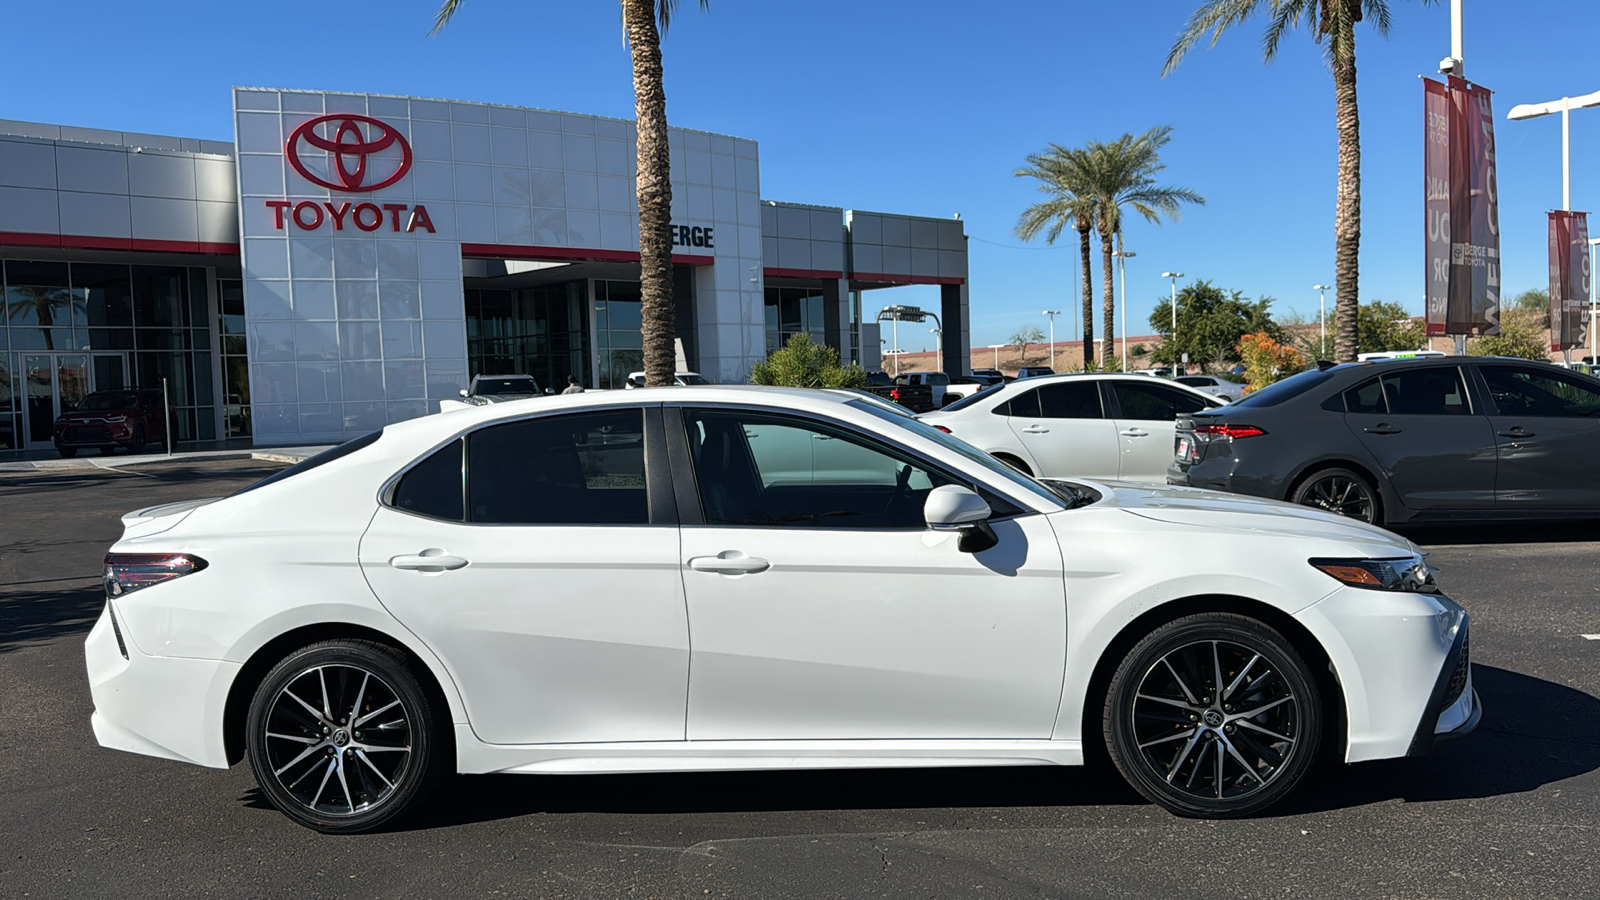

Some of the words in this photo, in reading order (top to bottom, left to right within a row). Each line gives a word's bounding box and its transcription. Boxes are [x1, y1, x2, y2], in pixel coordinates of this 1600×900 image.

[265, 200, 437, 233] TOYOTA
[668, 224, 714, 248] ERGE
[1464, 242, 1486, 258] BERGE
[1464, 256, 1486, 268] TOYOTA
